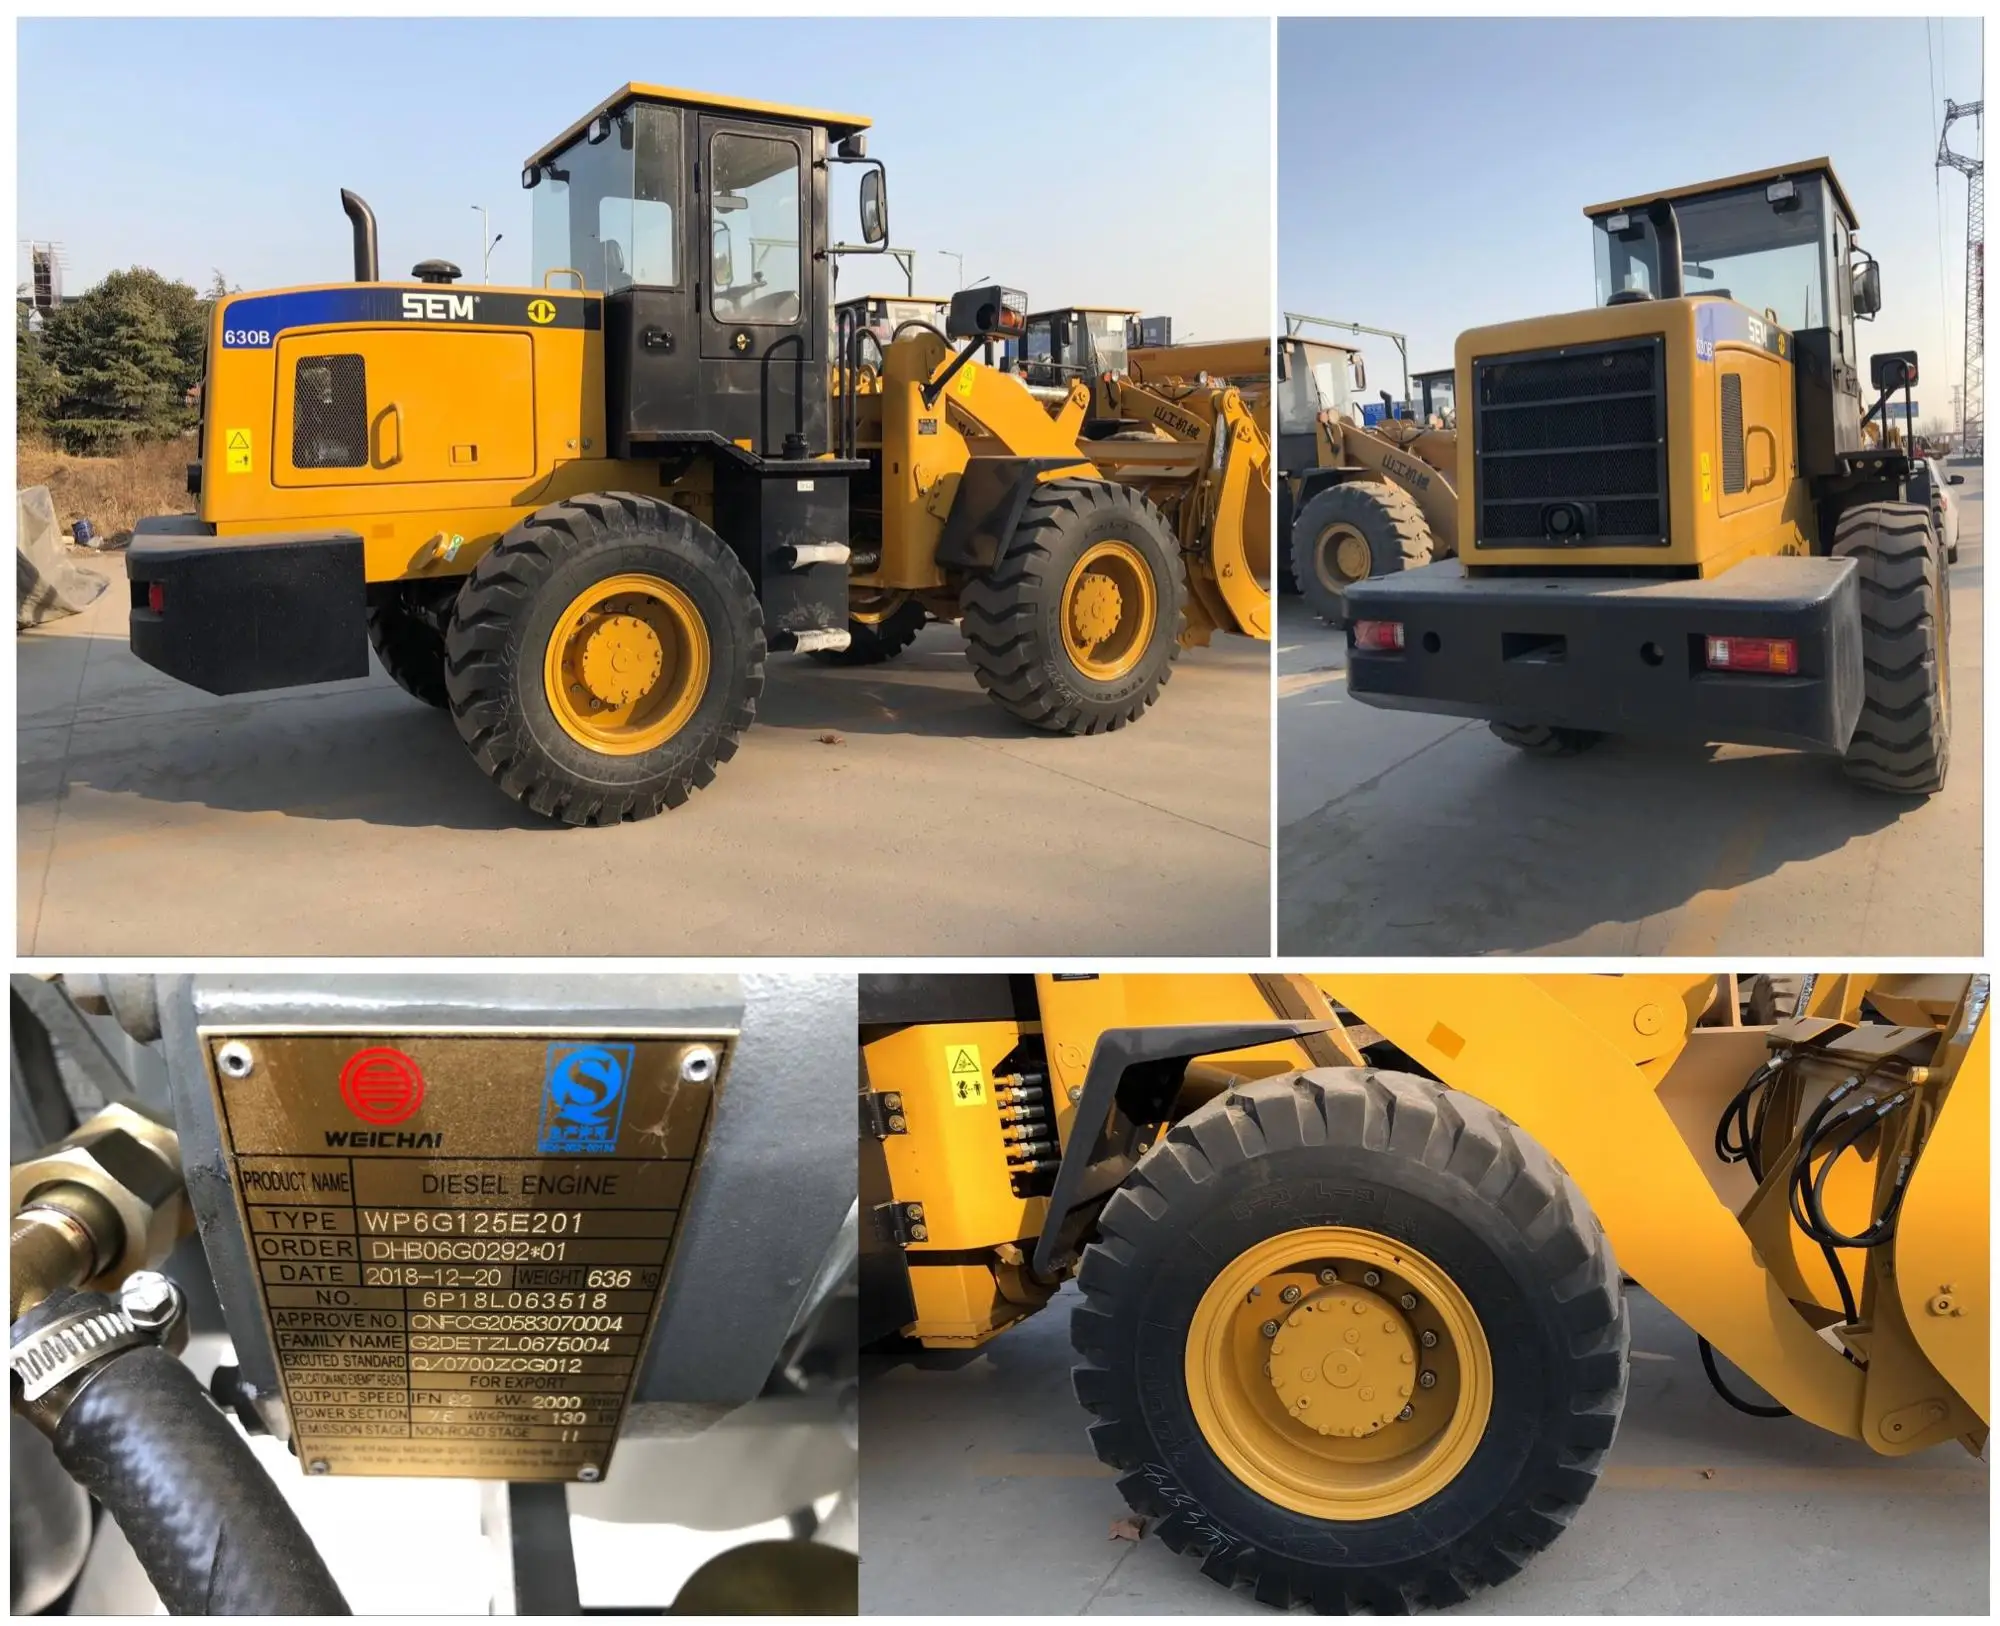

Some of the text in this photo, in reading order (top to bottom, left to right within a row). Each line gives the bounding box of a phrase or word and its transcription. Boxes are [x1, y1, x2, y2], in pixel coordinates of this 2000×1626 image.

[224, 329, 271, 346] 630B
[1153, 405, 1201, 441] 山工机械
[323, 1130, 443, 1150] WEICHAI
[243, 1170, 350, 1193] PRODUCT NAME
[422, 1174, 619, 1196] DIESEL ENGINE
[266, 1210, 337, 1231] TYPE
[364, 1211, 583, 1234] WP6G125E201
[261, 1237, 354, 1258] ORDER
[279, 1264, 345, 1283] DATE
[366, 1267, 502, 1287] 2018-12-20
[519, 1268, 583, 1286] WEIGHT
[587, 1269, 659, 1289] 636 kg
[316, 1289, 359, 1307] NO.
[422, 1291, 608, 1310] 6P18L063518
[275, 1311, 403, 1329] APPROVE NO.
[411, 1313, 624, 1332] CNFCG20583070004
[280, 1332, 404, 1350] FAMILY NAME
[410, 1335, 611, 1353] G2DETZL0675004
[283, 1353, 405, 1369] EXCUTED STANDARD
[469, 1375, 567, 1390] FOR EXPORT
[292, 1390, 405, 1404] OUTPUT-SPEED
[531, 1395, 582, 1409] 2000
[293, 1407, 409, 1421] POWER SECTION
[552, 1411, 587, 1425] 130
[300, 1421, 407, 1436] EMISSION STAGE
[414, 1425, 487, 1437] NON-ROAD
[487, 1427, 531, 1438] STAGE
